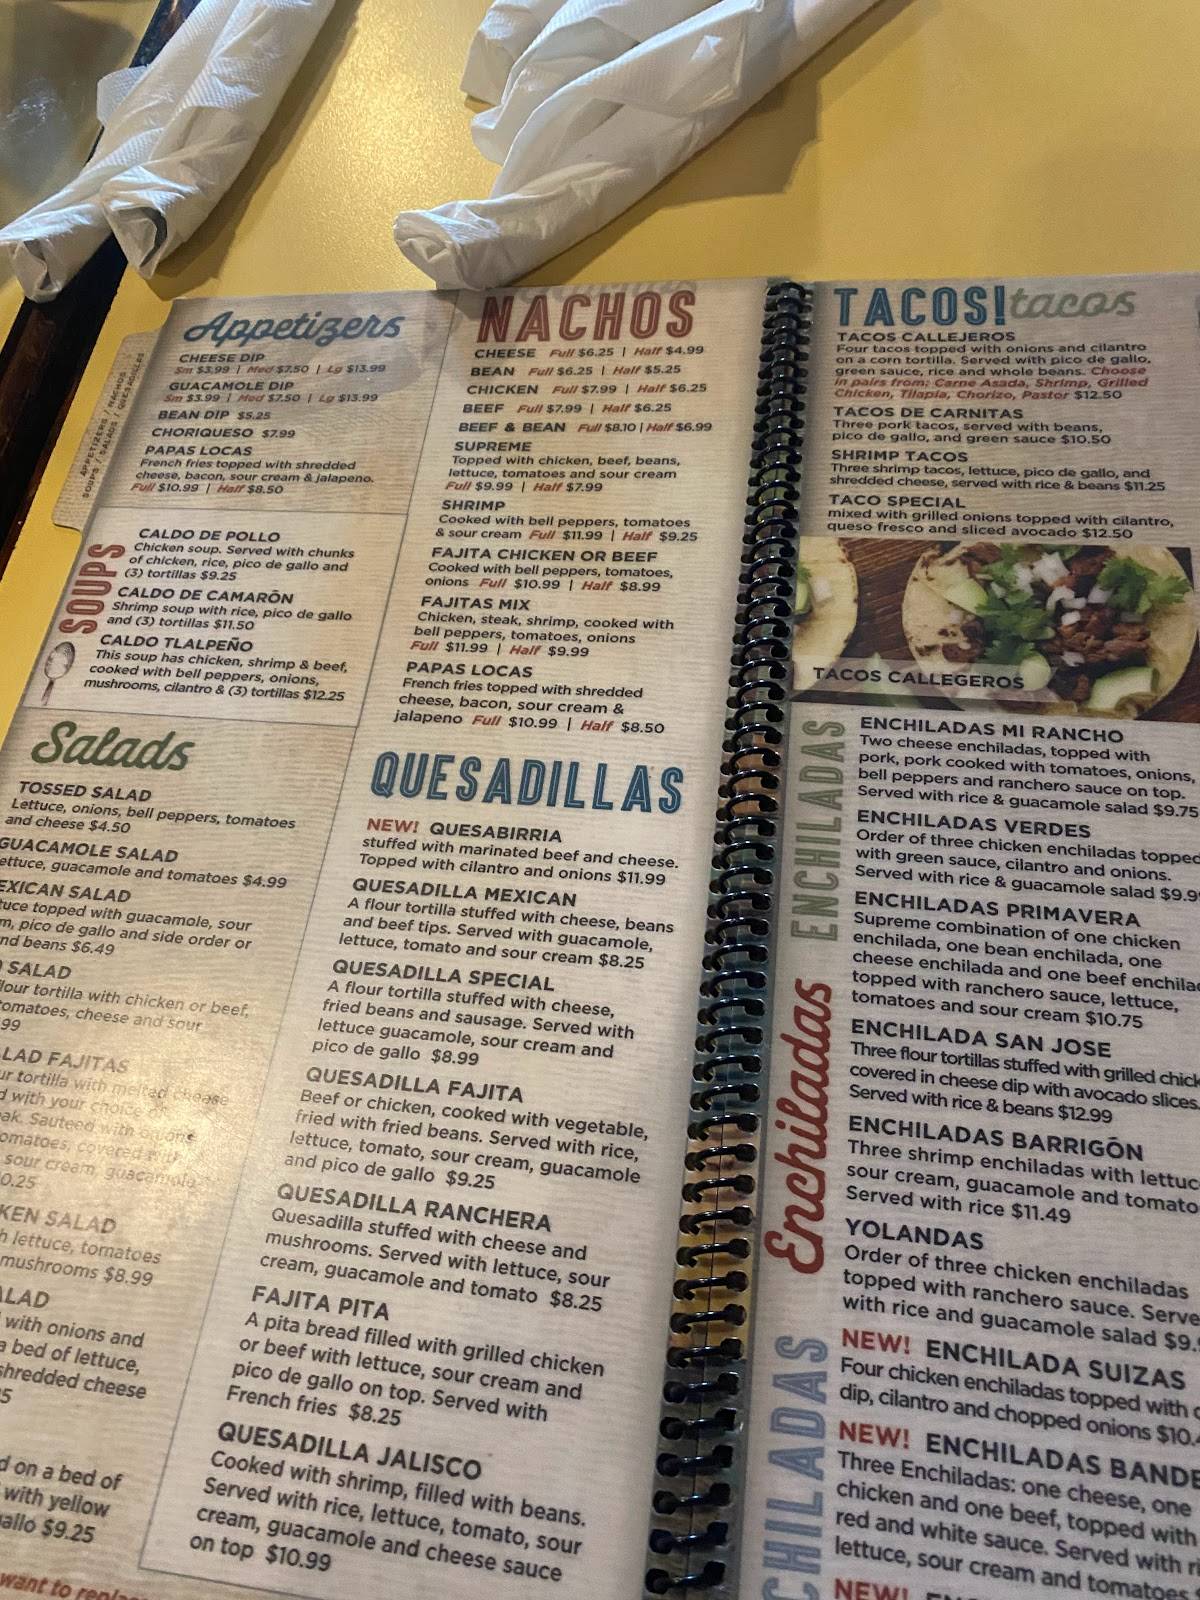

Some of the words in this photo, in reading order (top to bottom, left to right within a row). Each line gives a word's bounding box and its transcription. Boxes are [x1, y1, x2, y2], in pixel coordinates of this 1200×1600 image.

[477, 290, 696, 343] NACHOS
[833, 285, 1006, 327] TACOS!
[1010, 287, 1137, 319] tacos
[183, 310, 406, 348] Appetizers
[837, 331, 897, 343] TACOS
[901, 331, 1016, 343] CALLEJEROS
[178, 353, 238, 364] CHEESE
[239, 353, 266, 363] DIP
[168, 381, 265, 392] GUACAMOLE
[268, 381, 295, 391] DIP
[466, 384, 539, 396] CHICKEN
[551, 384, 579, 395] Full
[581, 384, 618, 395] $7.99
[636, 383, 667, 394] Half
[669, 383, 707, 394] $6.25
[157, 409, 201, 421] BEAN
[203, 409, 230, 420] DIP
[236, 410, 271, 421] $5.25
[832, 406, 895, 418] TACOS
[900, 406, 925, 418] DE
[930, 407, 1024, 420] CARNITAS
[151, 427, 254, 438] CHORIQUESO
[261, 429, 296, 439] $7.99
[454, 441, 533, 452] SUPREME
[832, 431, 864, 441] pico
[867, 431, 887, 441] de
[889, 431, 931, 444] gallo,
[932, 432, 962, 444] and
[966, 435, 1009, 445] green
[1013, 435, 1057, 444] sauce
[1060, 434, 1112, 445] $10.50
[140, 458, 182, 468] French
[185, 458, 214, 469] fries
[215, 459, 262, 471] topped
[265, 459, 292, 470] with
[295, 460, 357, 471] shredded
[144, 445, 197, 456] PAPAS
[199, 445, 253, 457] LOCAS
[452, 455, 502, 467] Topped
[505, 455, 535, 465] with
[538, 455, 593, 467] chicken,
[597, 455, 632, 467] beef,
[635, 455, 681, 467] beans,
[831, 449, 900, 461] SHRIMP
[904, 450, 969, 463] TACOS
[441, 499, 506, 512] SHRIMP
[828, 493, 882, 506] TACO
[887, 495, 967, 509] SPECIAL
[138, 528, 195, 540] CALDO
[198, 529, 223, 541] DE
[225, 530, 281, 543] POLLO
[431, 546, 492, 560] FAJITA
[497, 548, 576, 562] CHICKEN
[580, 550, 607, 562] OR
[611, 551, 658, 563] BEEF
[59, 544, 126, 634] SOUPS
[420, 595, 494, 610] FAJITAS
[498, 598, 531, 611] MIX
[100, 633, 159, 648] CALDO
[164, 636, 254, 653] TLALPEÑO
[406, 661, 466, 676] PAPAS
[471, 664, 533, 679] LOCAS
[813, 666, 882, 682] TACOS
[887, 669, 1025, 690] CALLEGEROS
[83, 678, 161, 694] mushrooms,
[163, 681, 213, 695] cilantro
[214, 684, 225, 695] &
[227, 685, 248, 698] (3)
[250, 686, 301, 700] tortillas
[302, 688, 346, 702] $12.25
[860, 716, 996, 736] ENCHILADAS
[1002, 724, 1024, 738] MI
[1031, 725, 1124, 744] RANCHO
[31, 720, 195, 771] Salads
[19, 780, 88, 798] TOSSED
[90, 785, 152, 803] SALAD
[370, 751, 684, 815] QUESADILLAS
[4, 814, 34, 826] and
[35, 816, 85, 831] cheese
[87, 819, 132, 834] $4.50
[10, 797, 67, 815] Lettuce,
[71, 803, 122, 819] onions,
[125, 805, 155, 819] bell
[155, 810, 221, 826] peppers,
[225, 814, 296, 829] tomatoes
[857, 809, 997, 832] ENCHILADAS
[1004, 818, 1091, 839] VERDES
[366, 818, 420, 834] NEW!
[429, 821, 563, 844] QUESABIRRIA
[791, 720, 845, 942] ENCHILADAS
[359, 852, 418, 869] Topped
[422, 857, 455, 871] with
[459, 860, 520, 876] cilantro
[523, 865, 554, 878] and
[558, 867, 612, 882] onions
[616, 870, 666, 886] $11.99
[352, 877, 478, 900] QUESADILLA
[484, 887, 577, 907] MEXICAN
[855, 890, 999, 917] ENCHILADAS
[1006, 903, 1141, 928] PRIMAVERA
[338, 932, 398, 952] lettuce,
[403, 938, 462, 954] tomato
[465, 944, 497, 958] and
[500, 948, 538, 960] sour
[541, 951, 593, 965] cream
[598, 952, 645, 970] $8.25
[332, 958, 462, 984] QUESADILLA
[468, 969, 555, 992] SPECIAL
[851, 1018, 988, 1047] ENCHILADA
[995, 1032, 1043, 1052] SAN
[1051, 1037, 1112, 1059] JOSE
[306, 1066, 440, 1095] QUESADILLA
[447, 1080, 524, 1104] FAJITA
[849, 1083, 908, 1104] Served
[911, 1091, 948, 1108] with
[951, 1094, 983, 1111] rice
[985, 1097, 1000, 1113] &
[1002, 1098, 1055, 1119] beans
[1057, 1104, 1113, 1124] $12.99
[764, 978, 832, 1274] Enchiladas
[277, 1182, 417, 1217] QUESADILLA
[424, 1200, 552, 1233] RANCHERA
[845, 1217, 984, 1251] YOLANDAS
[251, 1285, 330, 1313] FAJITA
[338, 1297, 389, 1322] PITA
[5, 1316, 43, 1334] with
[46, 1322, 107, 1343] onions
[109, 1331, 146, 1349] and
[842, 1327, 910, 1355] NEW!
[926, 1338, 1081, 1378] ENCHILADA
[1088, 1359, 1186, 1391] SUIZAS
[226, 1384, 291, 1410] French
[296, 1394, 338, 1417] fries
[347, 1402, 403, 1427] $8.25
[217, 1421, 369, 1464] QUESADILLA
[376, 1446, 482, 1481] JALISCO
[839, 1450, 895, 1476] Three
[901, 1459, 1016, 1494] Enchiladas:
[1021, 1480, 1062, 1500] one
[1066, 1483, 1146, 1514] cheese,
[1151, 1498, 1192, 1518] one
[3, 1485, 44, 1507] with
[46, 1493, 111, 1518] yellow
[189, 1535, 216, 1553] on
[220, 1536, 255, 1562] top
[264, 1543, 332, 1572] $10.99
